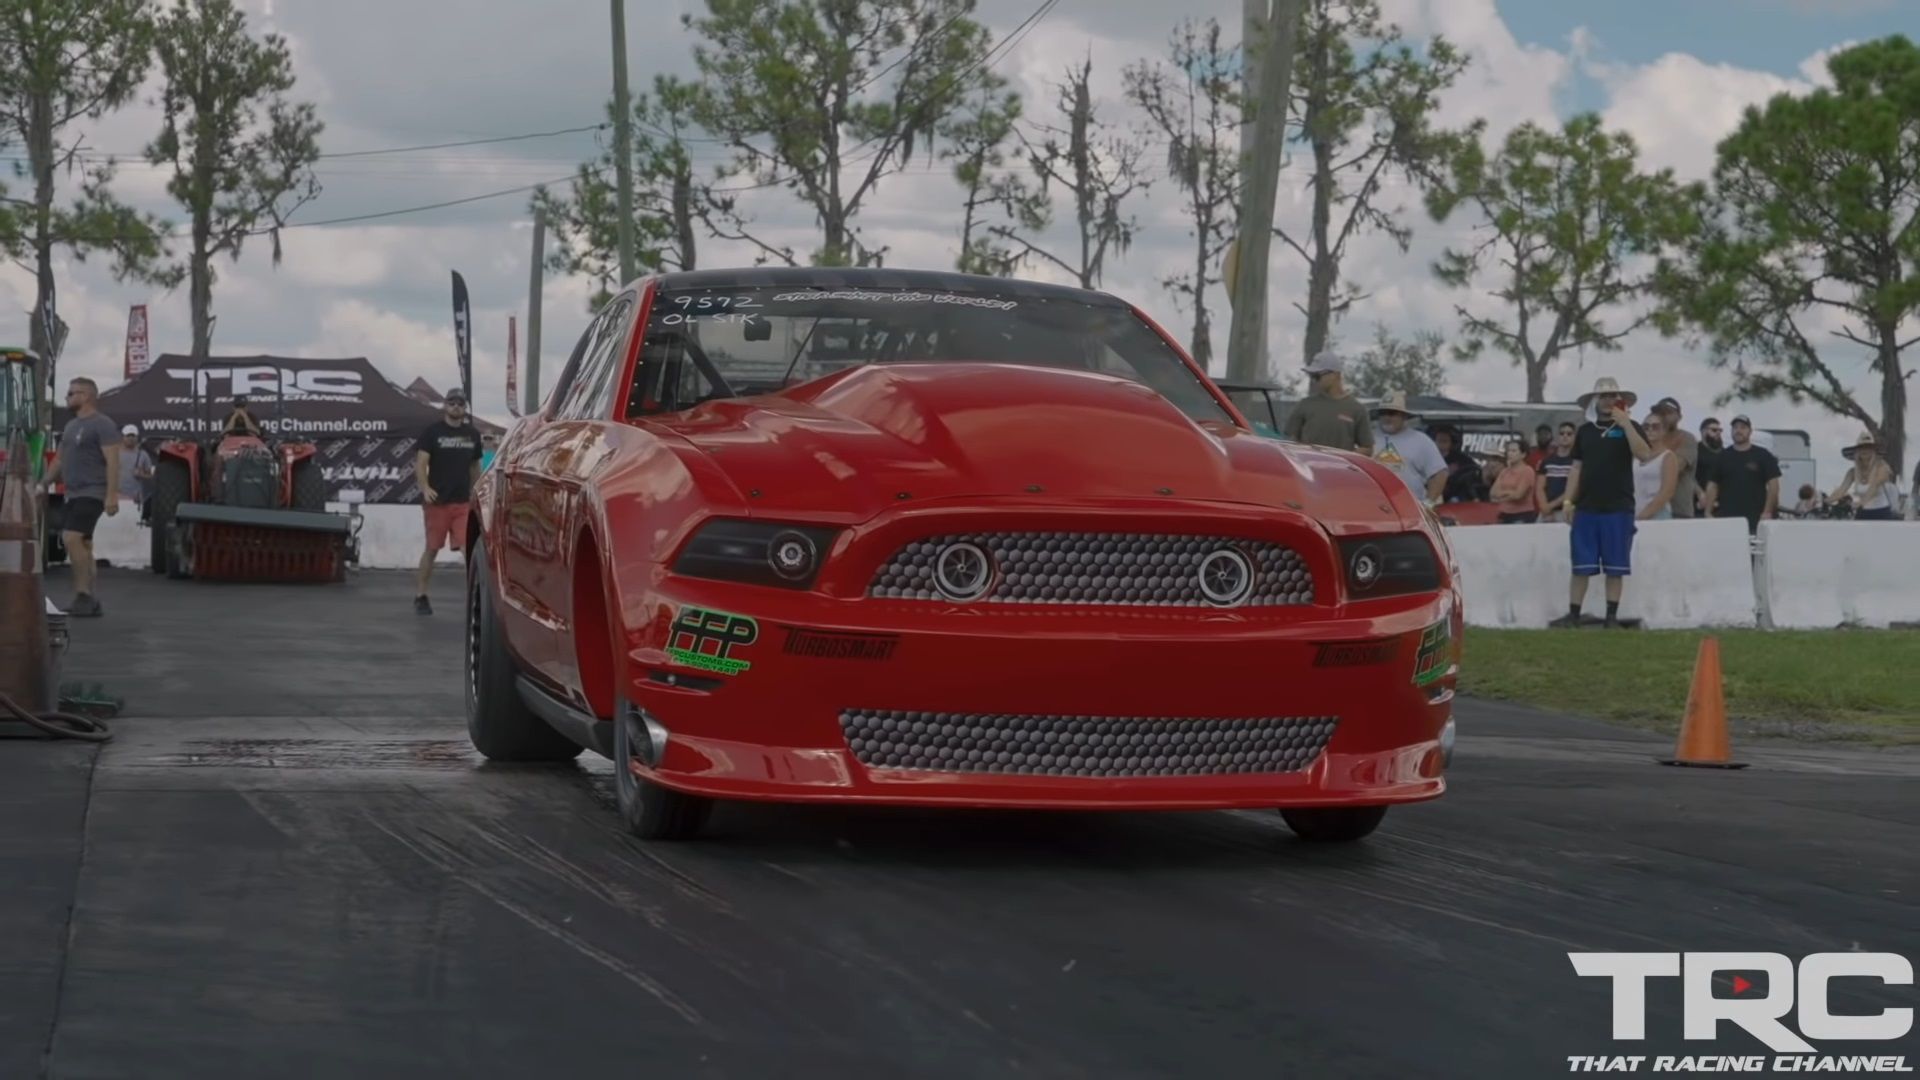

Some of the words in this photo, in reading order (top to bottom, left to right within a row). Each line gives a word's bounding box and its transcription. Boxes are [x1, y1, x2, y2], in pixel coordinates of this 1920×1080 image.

[674, 295, 764, 310] 9572
[165, 366, 363, 395] TRC
[214, 395, 278, 403] RAING
[282, 393, 364, 403] CHANNEL
[778, 626, 900, 660] TURBOSMART
